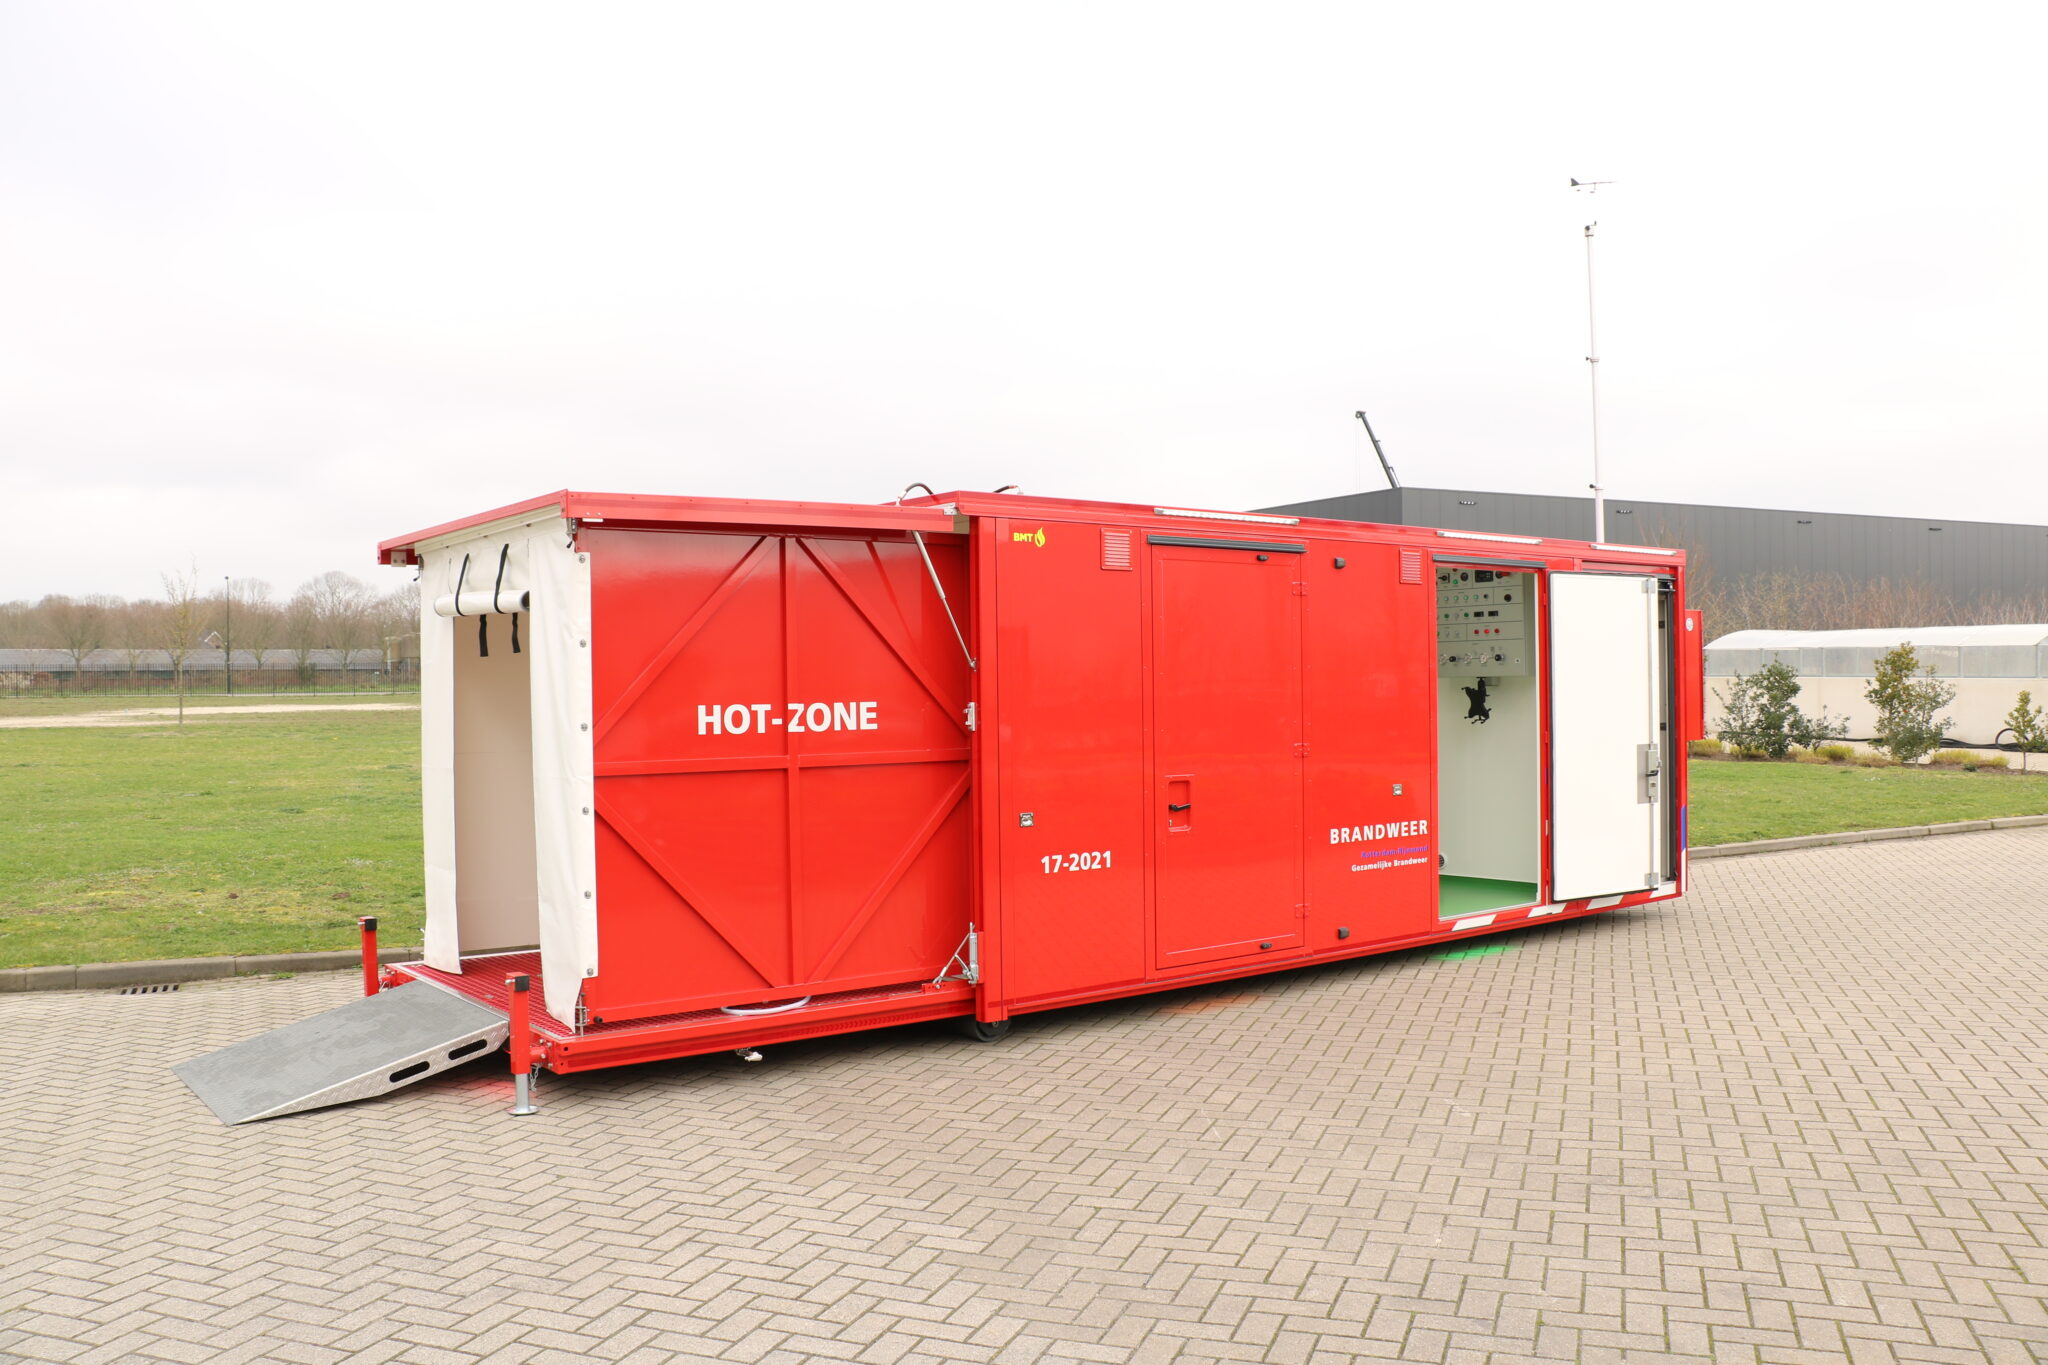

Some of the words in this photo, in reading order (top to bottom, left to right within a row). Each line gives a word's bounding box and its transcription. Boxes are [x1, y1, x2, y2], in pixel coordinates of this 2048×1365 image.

[1013, 532, 1034, 542] BMT
[697, 701, 878, 735] HOT-ZONE
[1330, 820, 1428, 844] BRANDWEER
[1040, 850, 1112, 874] 17-2021
[1393, 857, 1428, 867] Brandweer
